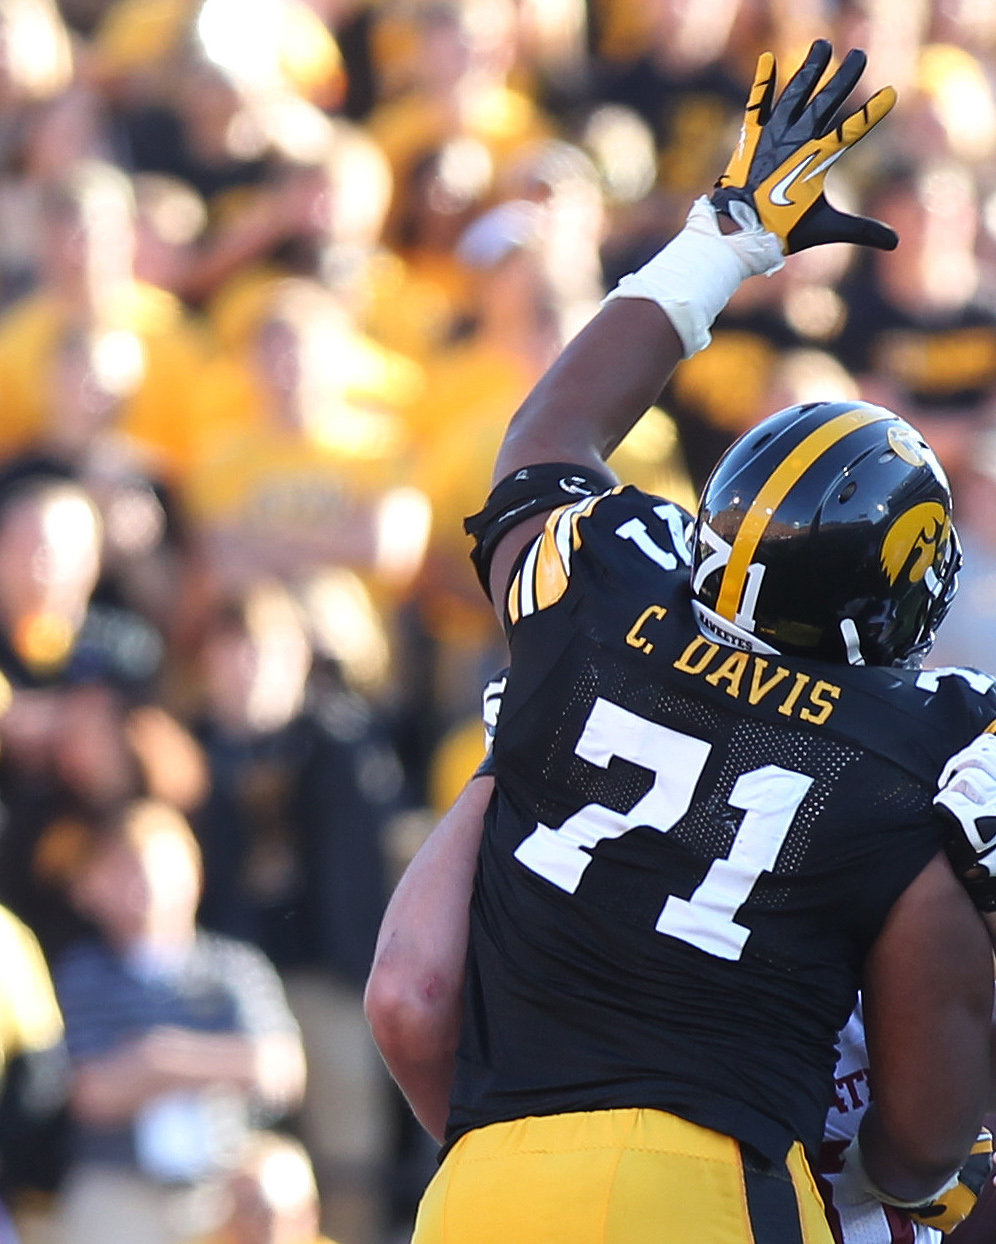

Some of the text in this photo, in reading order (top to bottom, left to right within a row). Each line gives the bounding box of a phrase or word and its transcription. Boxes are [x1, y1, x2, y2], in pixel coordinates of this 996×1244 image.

[693, 521, 767, 633] 71
[625, 604, 842, 725] C. DAVIS
[513, 696, 816, 961] 71
